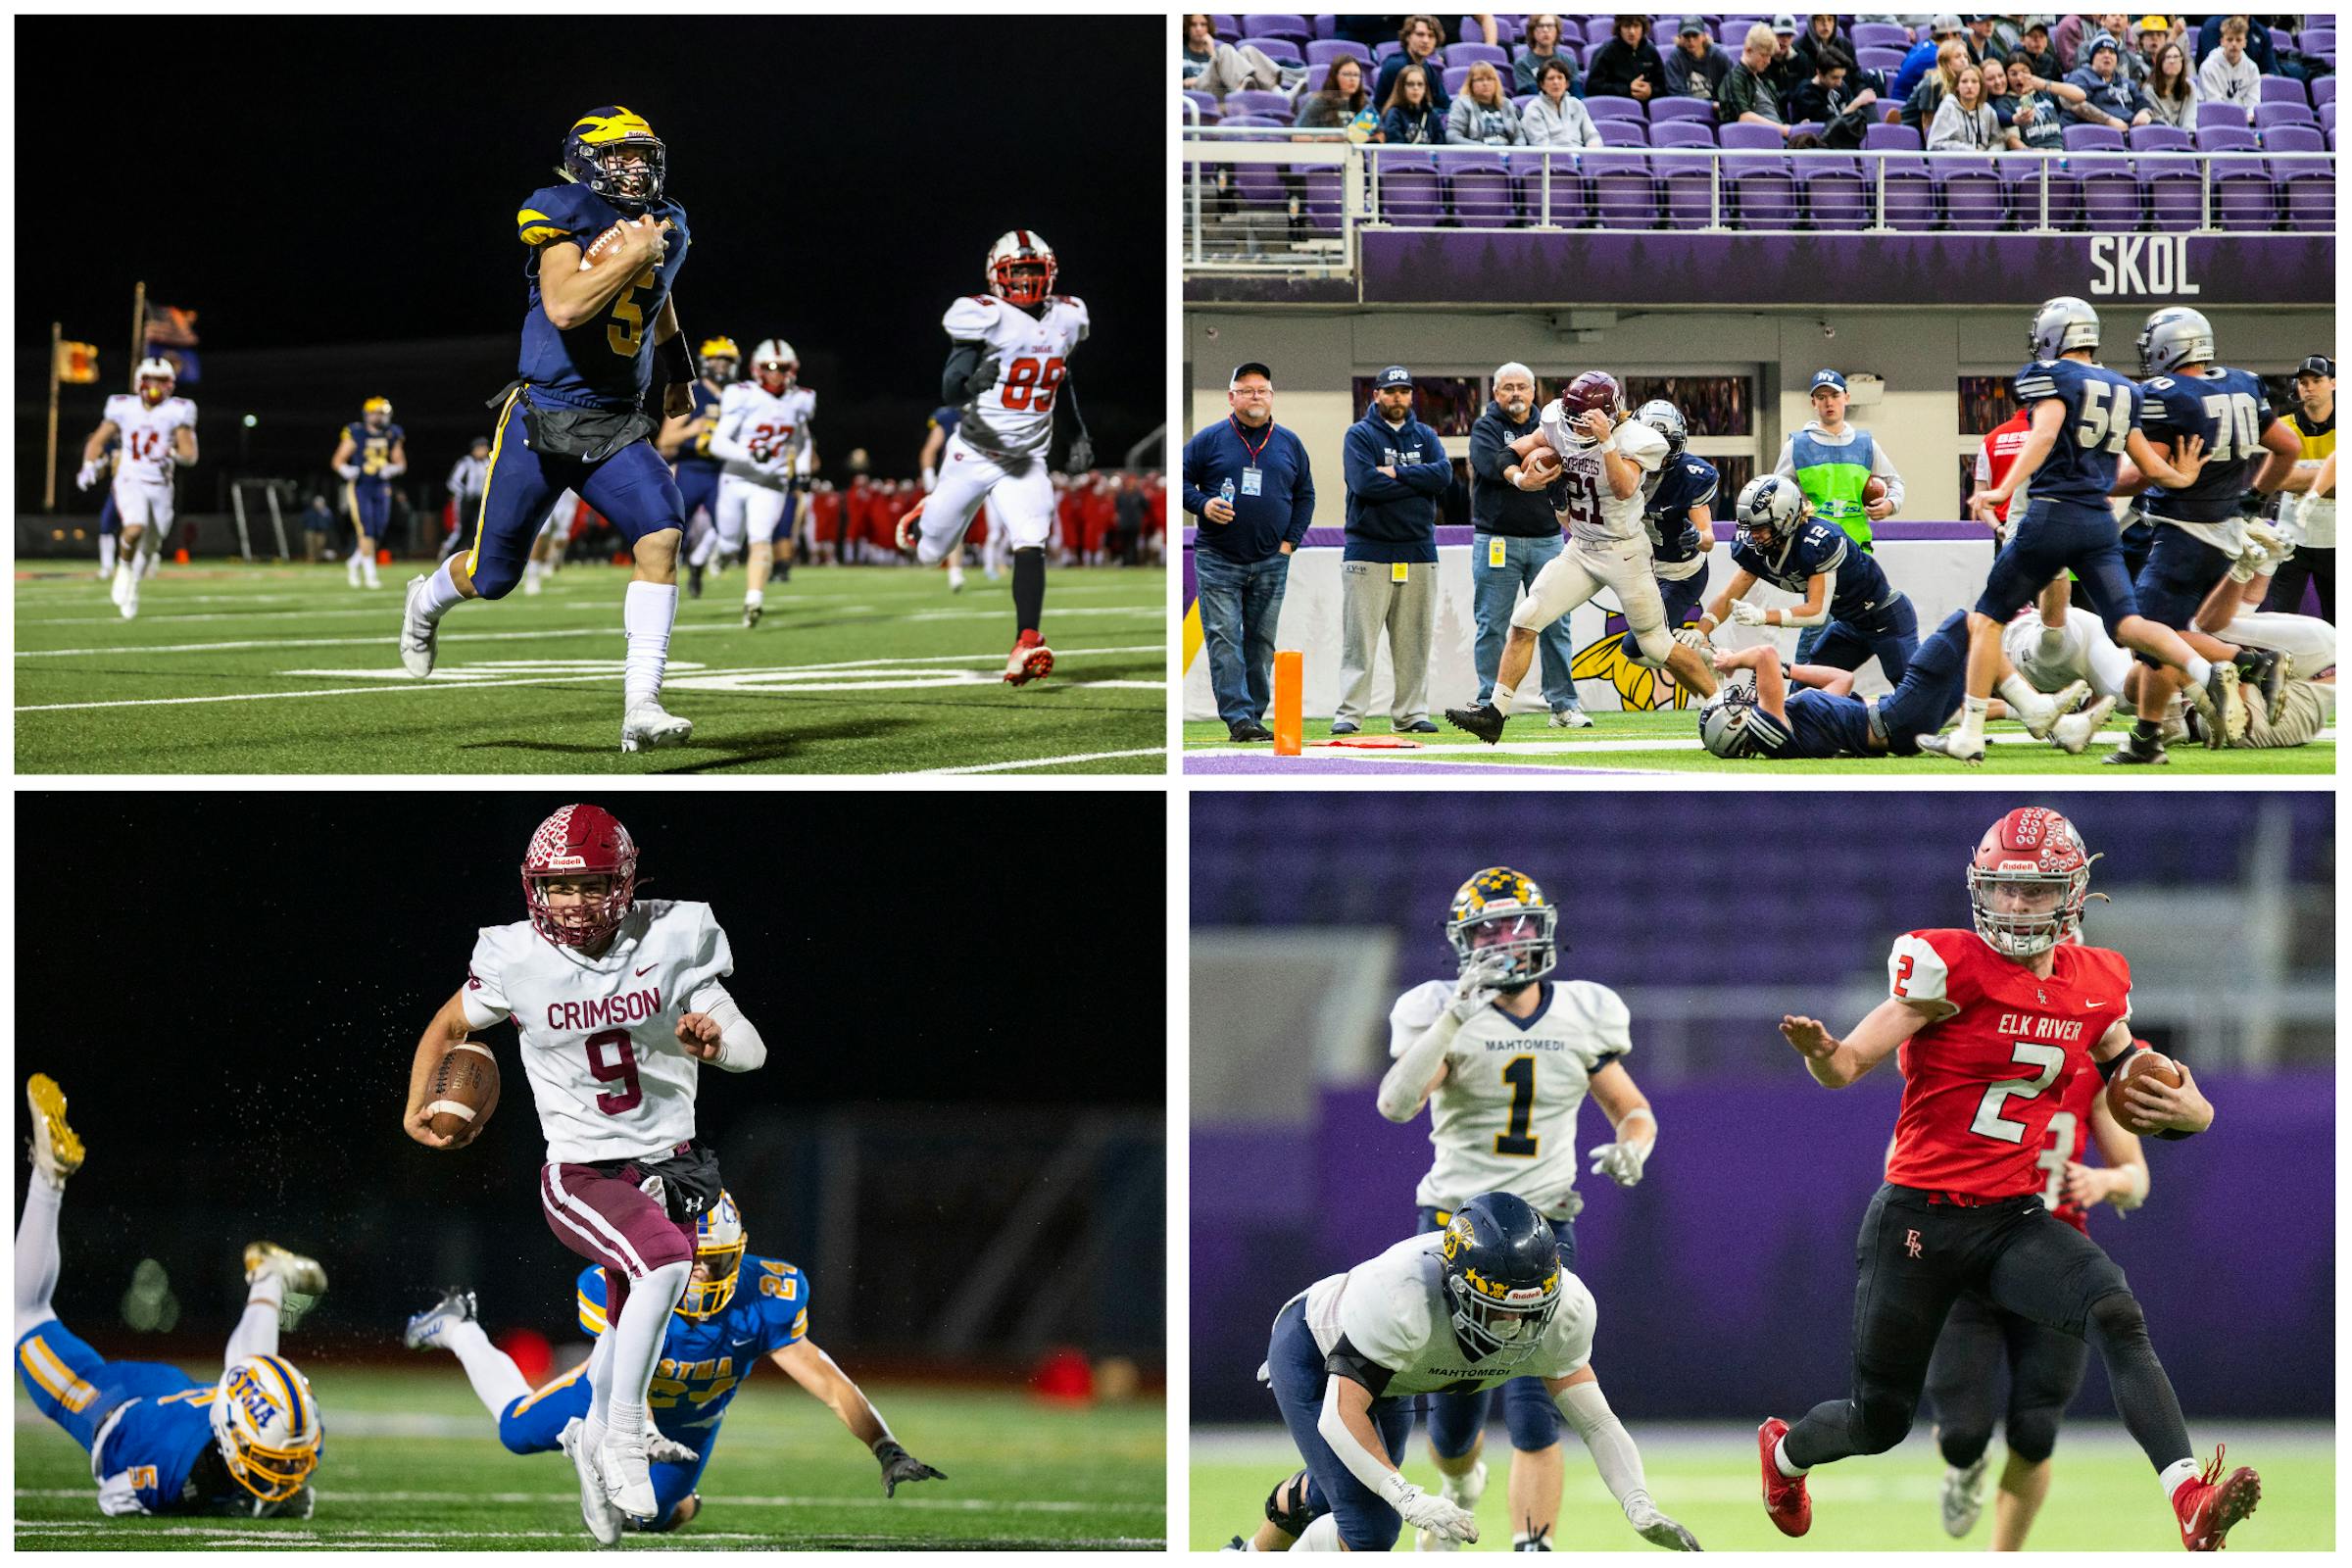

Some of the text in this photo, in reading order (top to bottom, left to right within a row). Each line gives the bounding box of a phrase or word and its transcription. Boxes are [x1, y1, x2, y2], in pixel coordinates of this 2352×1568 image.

[2089, 235, 2200, 295] SKOL
[607, 270, 656, 359] 5
[1000, 357, 1067, 413] 89
[1996, 430, 2031, 444] BES
[2077, 378, 2132, 455] 54
[2200, 392, 2260, 462] 70
[1566, 472, 1605, 525] 21
[1803, 524, 1831, 547] 12
[552, 857, 582, 866] Riddell
[2002, 862, 2034, 871] Riddell
[1893, 954, 1914, 998] 2
[547, 987, 662, 1030] CRIMSON
[1997, 1013, 2083, 1042] ELK RIVER
[1485, 1040, 1565, 1053] MAHTOMEDI
[584, 1028, 643, 1116] 9
[1969, 1041, 2067, 1145] 2
[1493, 1054, 1539, 1159] 1
[759, 1259, 799, 1301] 24
[1511, 1290, 1542, 1300] Riddell
[657, 1355, 733, 1381] STMA
[1427, 1367, 1511, 1378] MAHTOMEDI
[126, 1464, 159, 1491] 5
